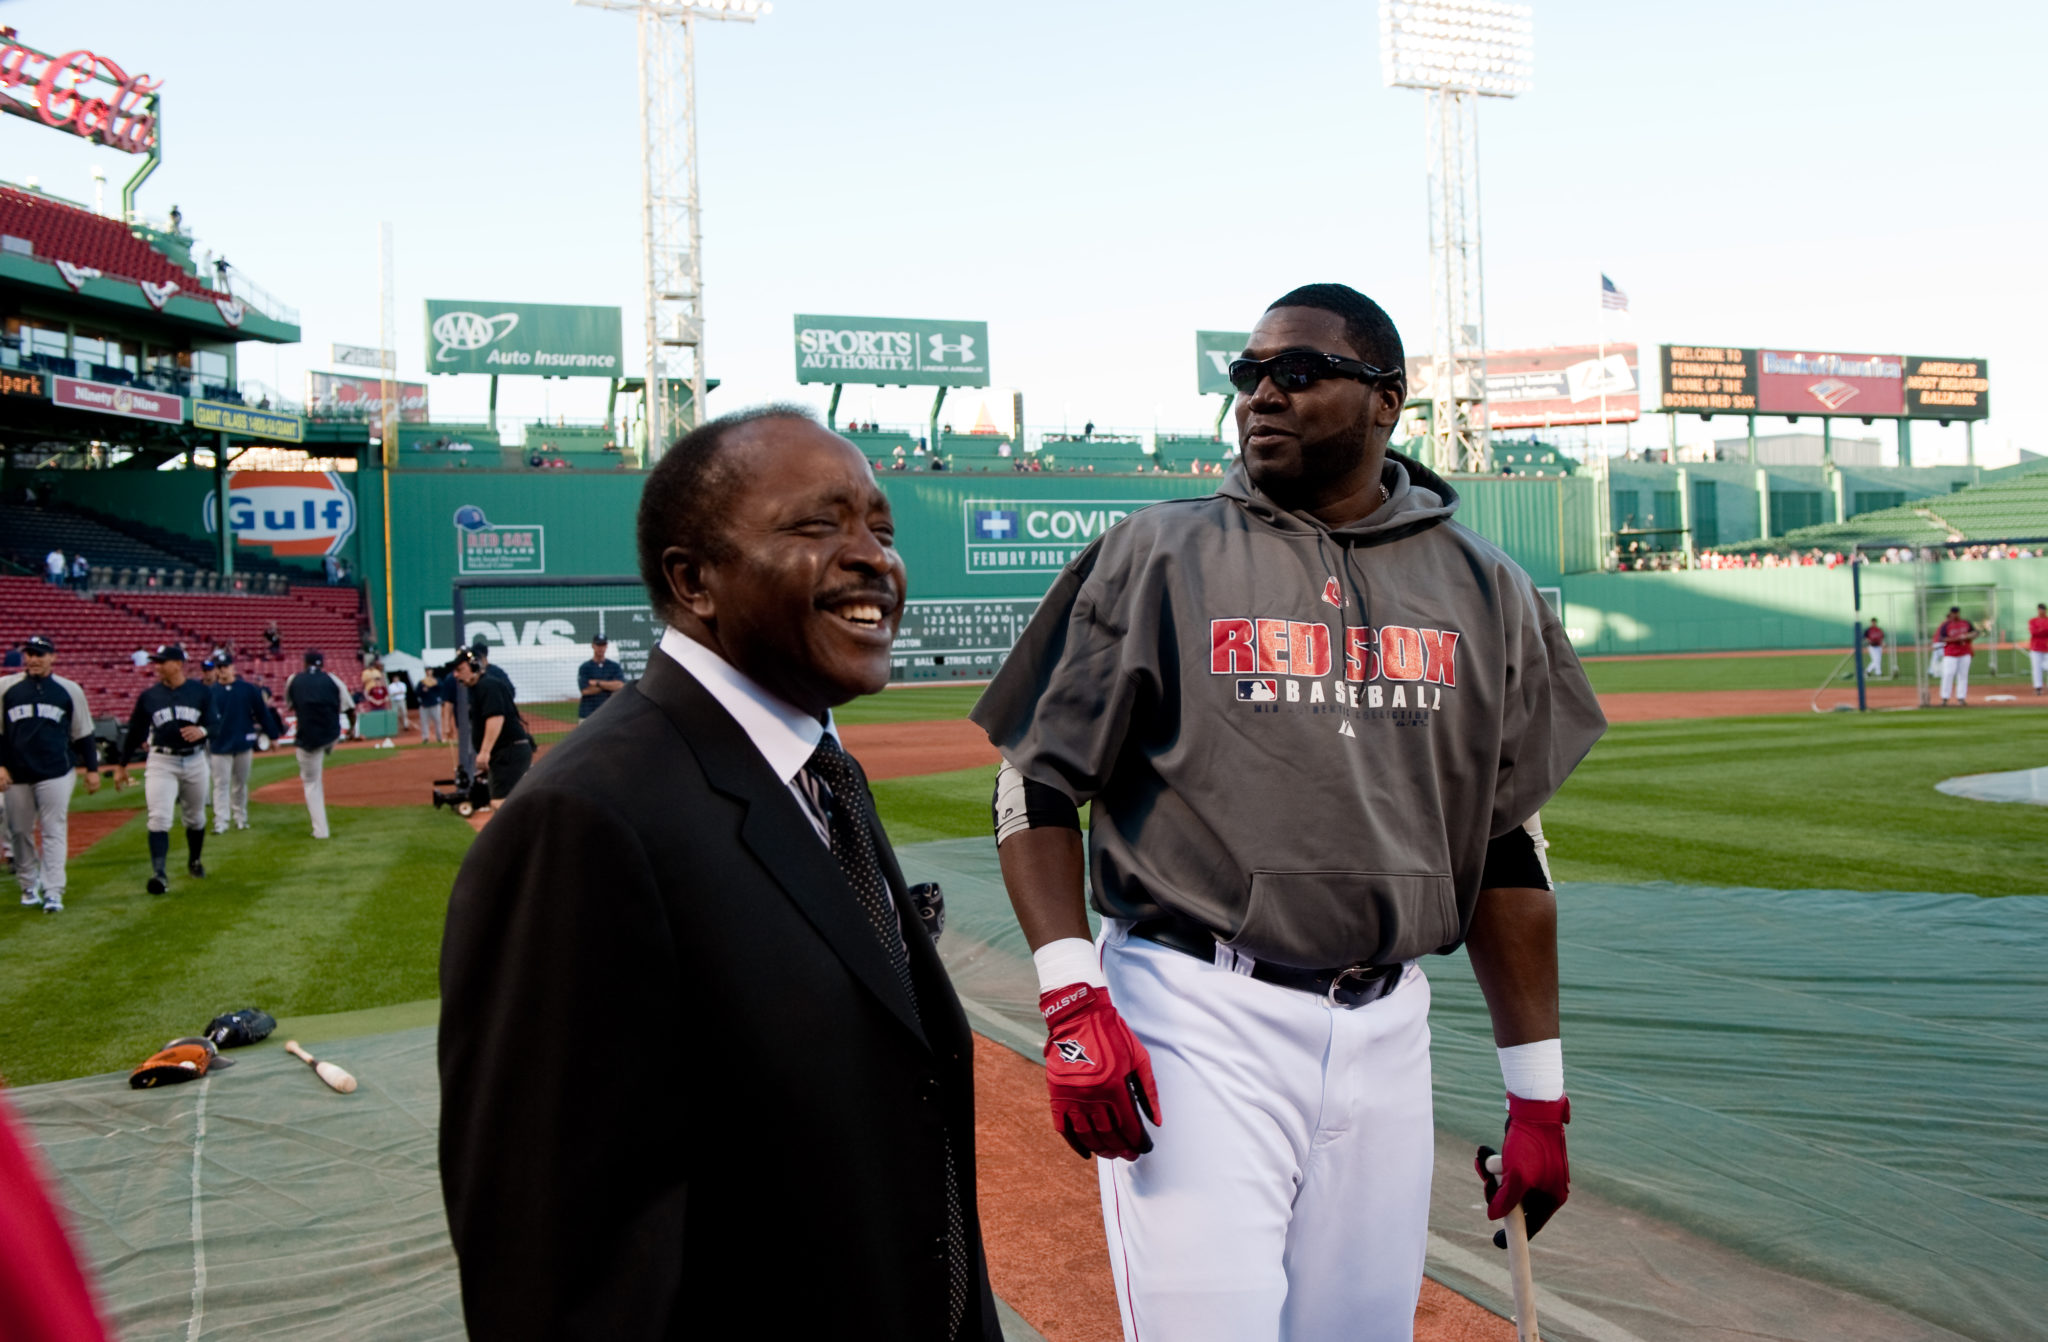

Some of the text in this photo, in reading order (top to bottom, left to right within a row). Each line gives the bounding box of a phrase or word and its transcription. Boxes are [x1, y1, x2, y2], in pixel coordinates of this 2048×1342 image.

[441, 314, 486, 347] AAA
[801, 328, 912, 356] SPORTS
[486, 350, 615, 367] Auto Insurance
[801, 354, 912, 371] AUTHORITY
[1670, 346, 1742, 363] WELCOME TO
[1670, 361, 1747, 378] FENWAY PARK
[1705, 378, 1721, 392] OF
[75, 386, 113, 406] Ninety
[1663, 393, 1756, 409] BOSTON RED SOX
[229, 497, 343, 530] Gulf
[467, 533, 534, 547] RED SOX
[973, 551, 1026, 566] FENWAY
[1031, 551, 1065, 565] PARK
[975, 605, 1013, 613] PARK
[464, 619, 576, 647] CVS
[914, 657, 935, 666] BALL
[944, 656, 972, 665] STRIKE
[975, 655, 993, 664] OUT
[1210, 617, 1460, 689] RED SOX
[1285, 679, 1441, 711] BASEBALL
[1041, 986, 1088, 1018] EASTON
